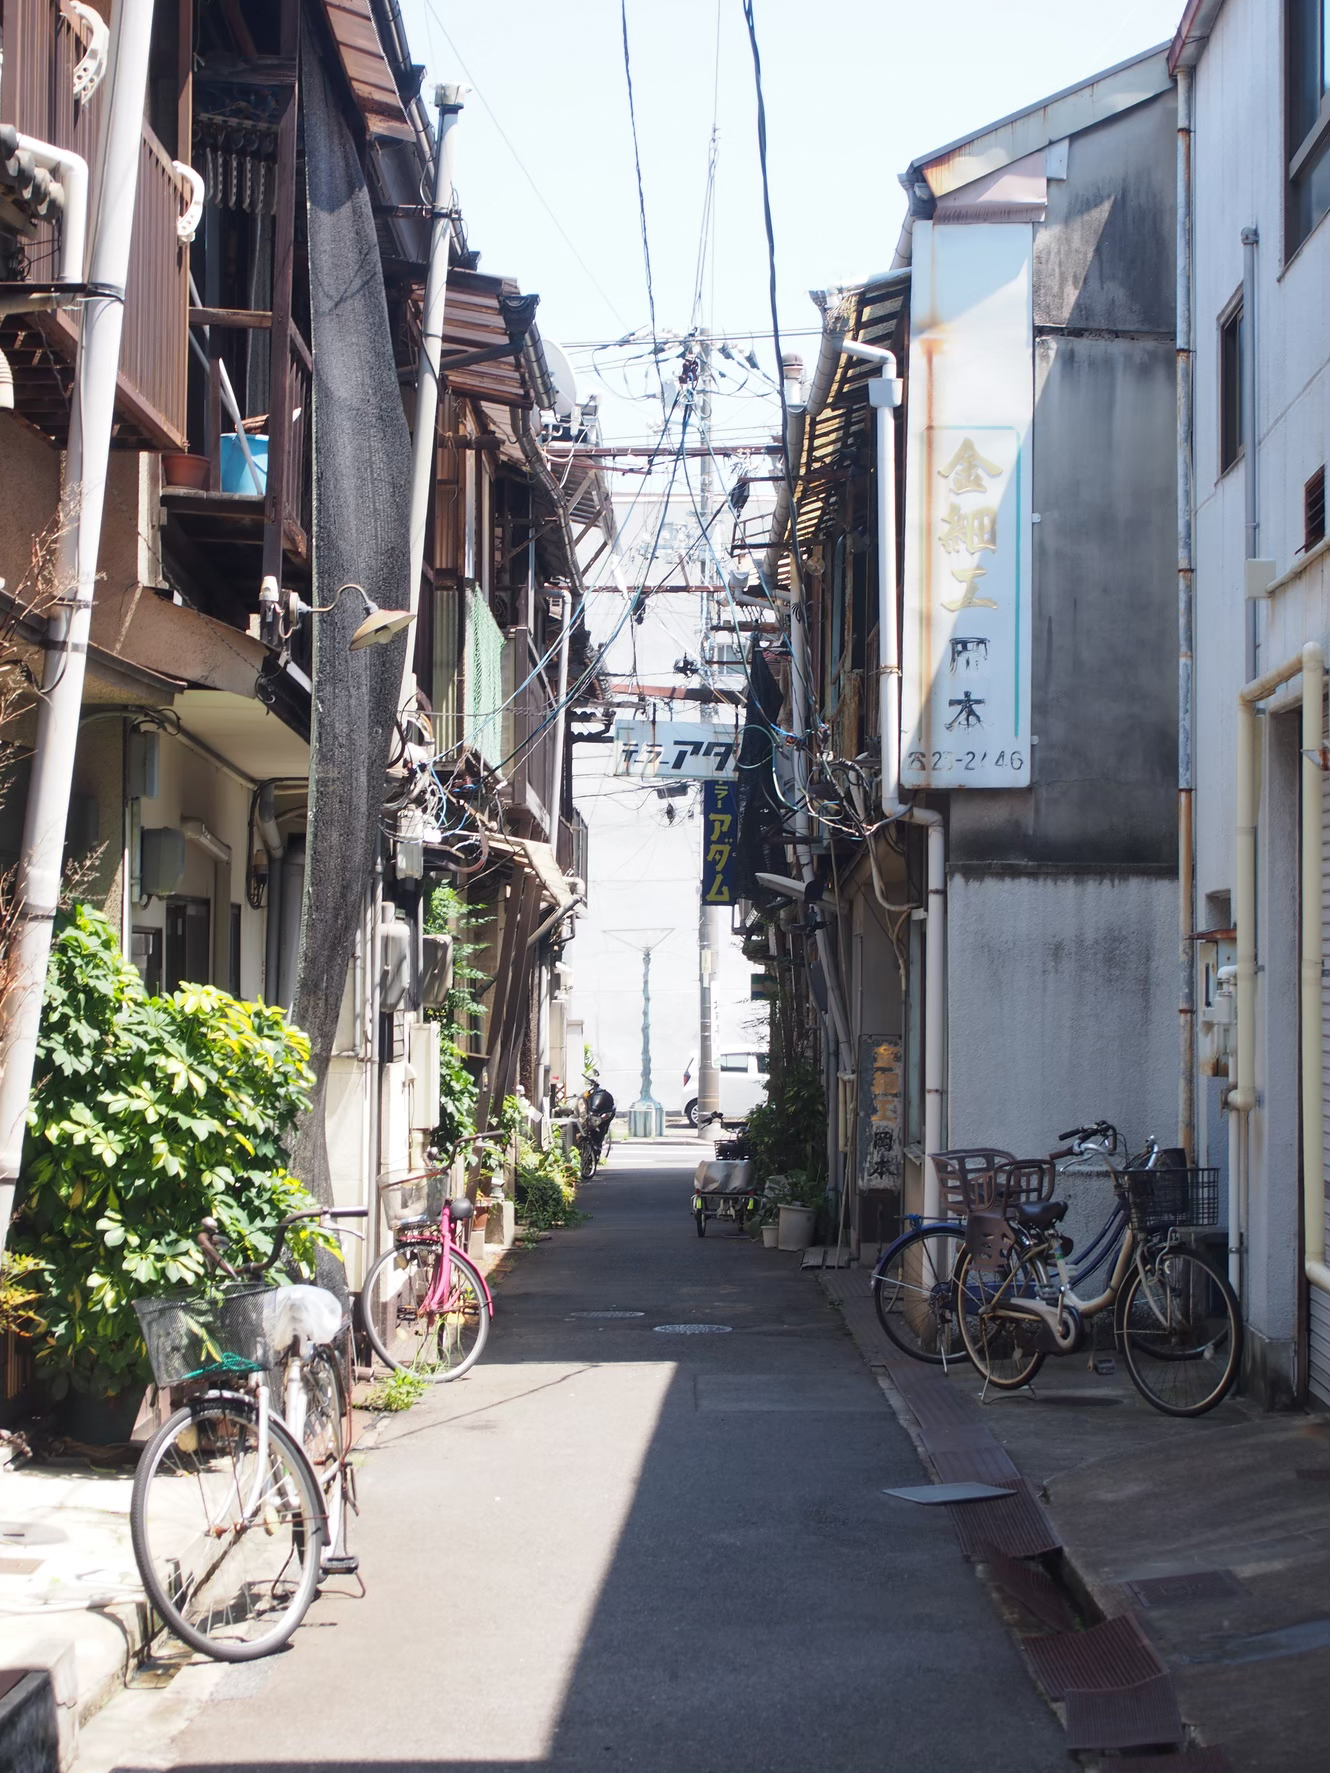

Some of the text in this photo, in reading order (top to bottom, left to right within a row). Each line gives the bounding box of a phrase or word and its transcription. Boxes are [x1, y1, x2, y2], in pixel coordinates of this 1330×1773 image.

[706, 780, 732, 901] ラーアダム
